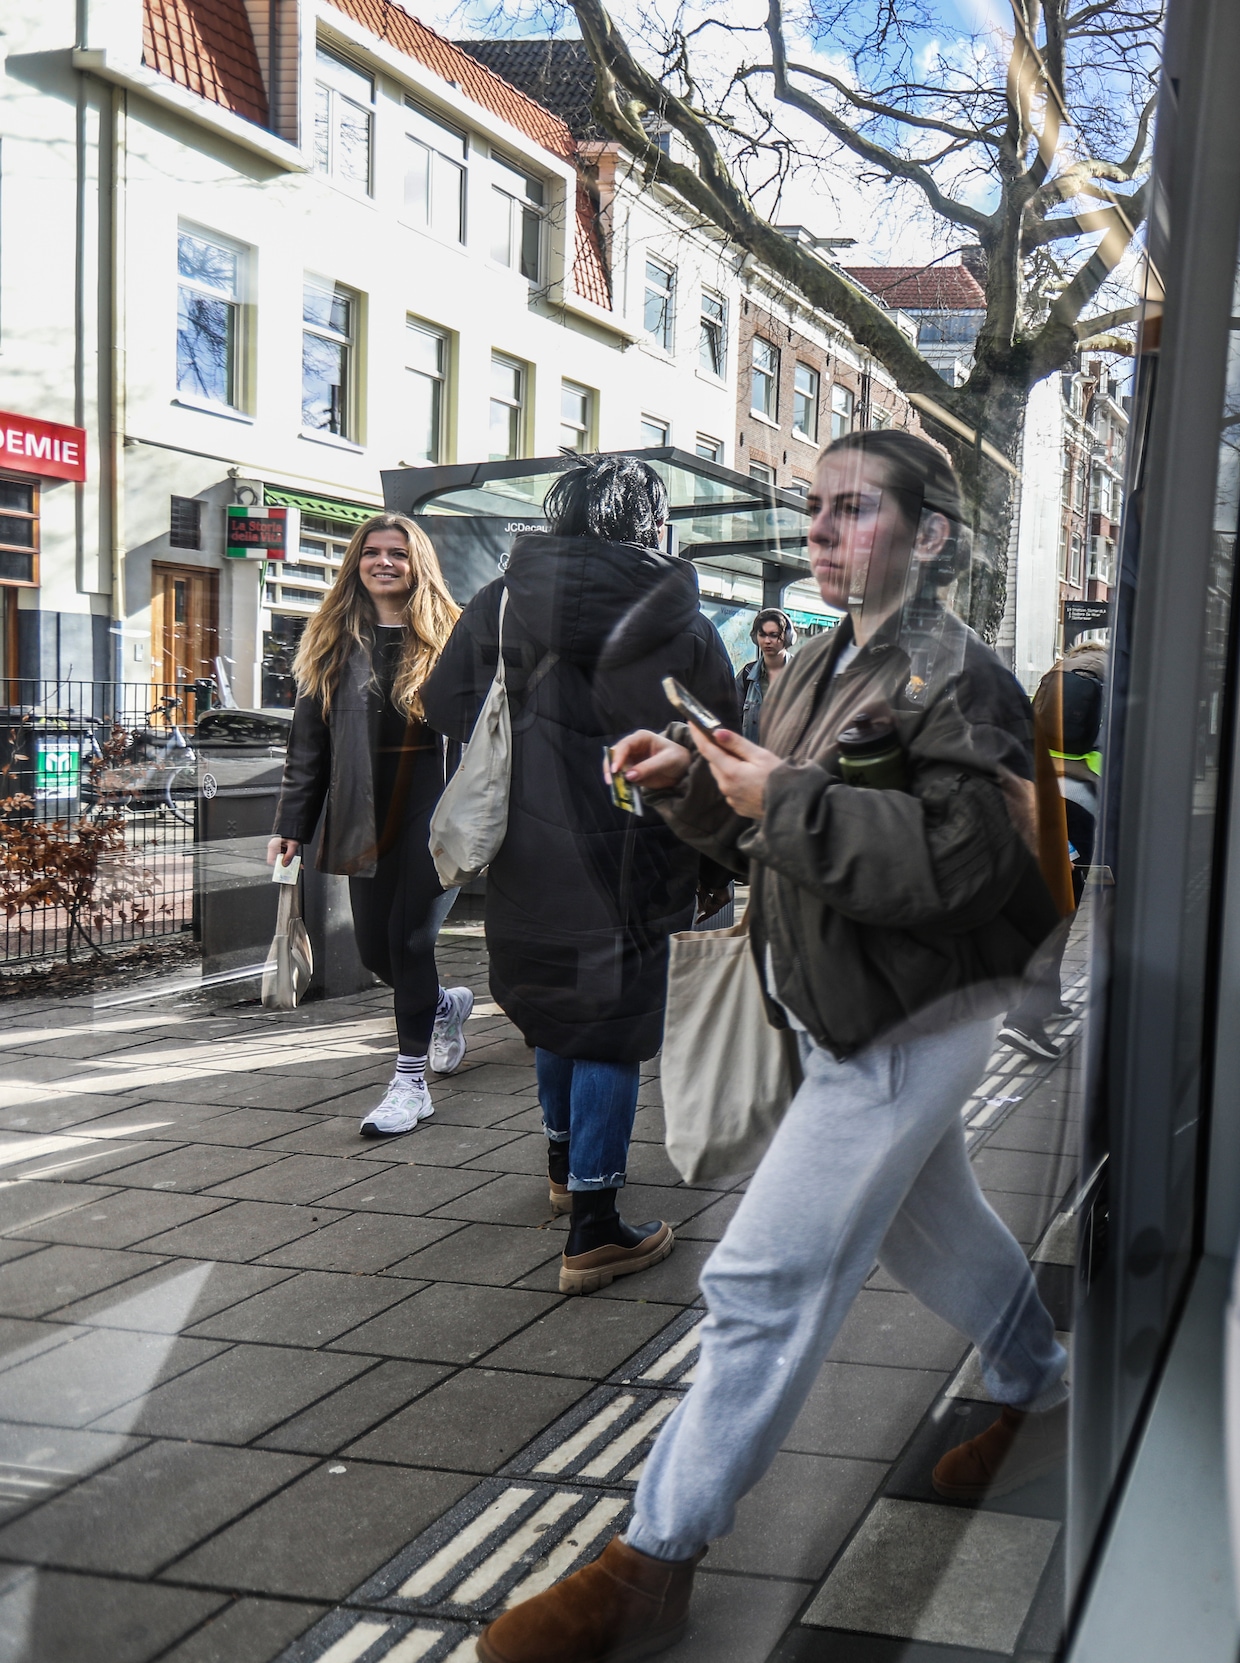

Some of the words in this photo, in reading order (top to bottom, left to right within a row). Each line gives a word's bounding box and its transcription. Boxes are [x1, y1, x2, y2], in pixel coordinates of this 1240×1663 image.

[0, 428, 79, 466] EMIE
[231, 520, 246, 531] La
[248, 521, 283, 533] Storia
[231, 530, 259, 542] della
